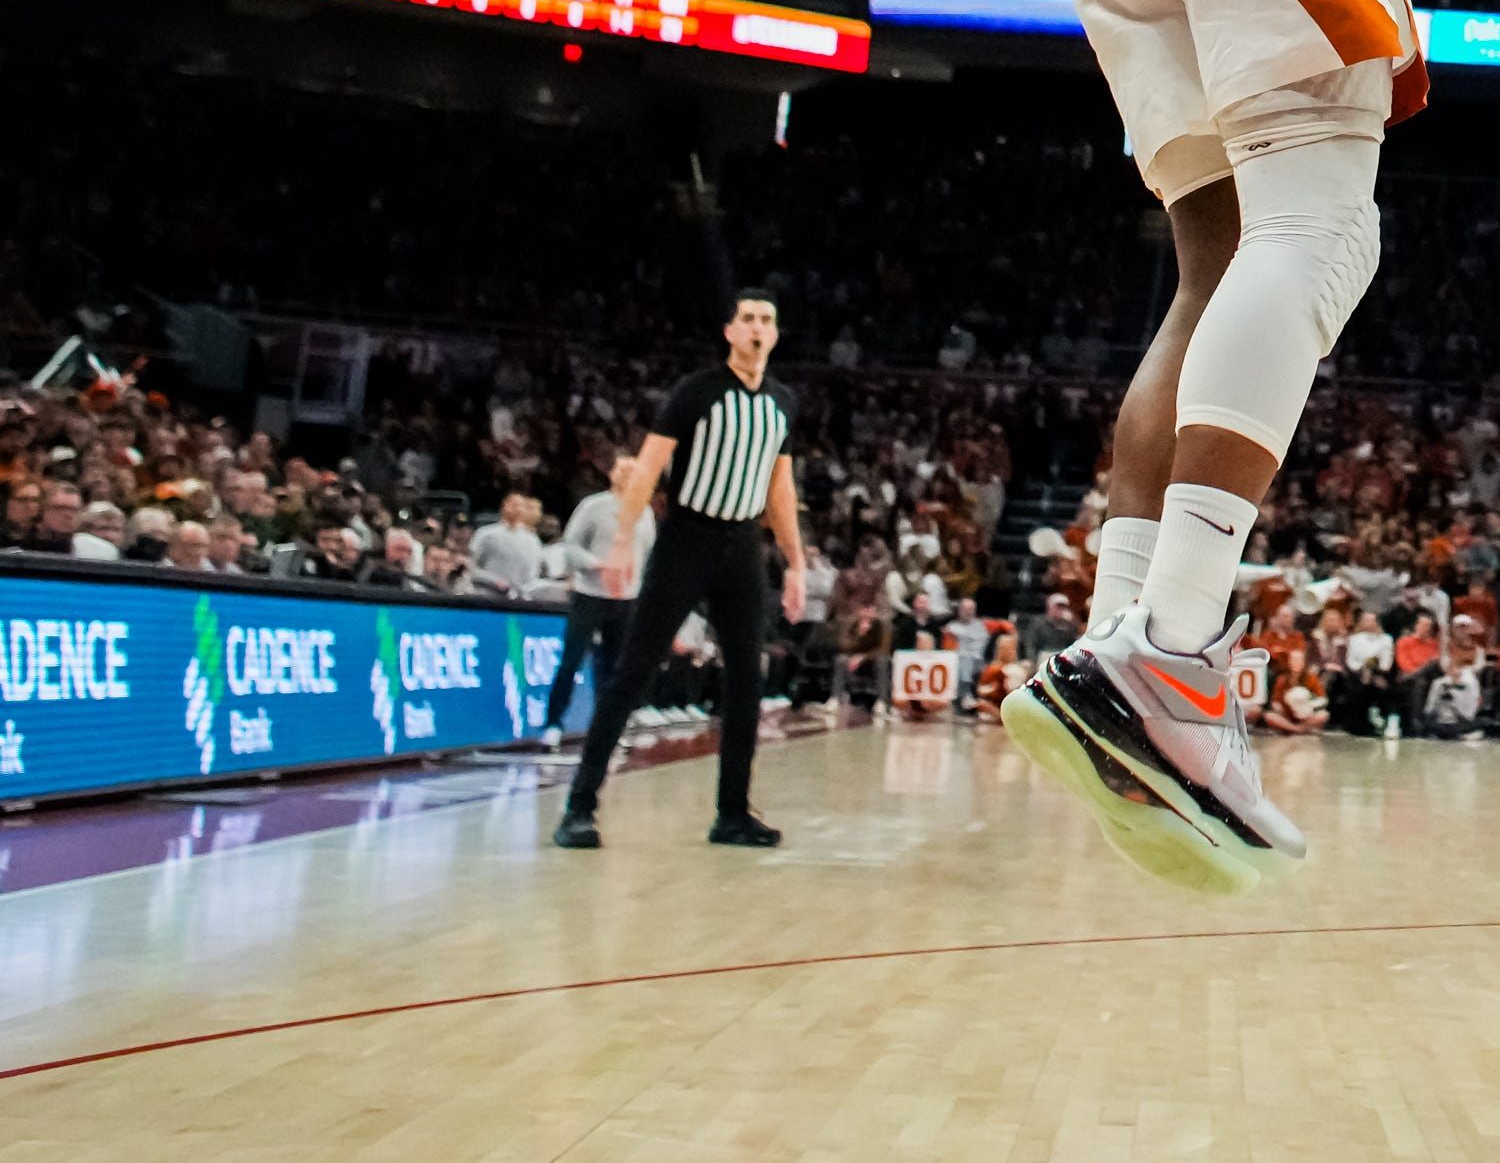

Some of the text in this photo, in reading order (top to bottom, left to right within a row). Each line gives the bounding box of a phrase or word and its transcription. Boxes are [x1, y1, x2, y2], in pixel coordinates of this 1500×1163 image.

[0, 619, 129, 701] DENCE
[227, 625, 339, 696] CADENCE
[400, 632, 481, 691] CADENCE
[903, 663, 948, 695] GO
